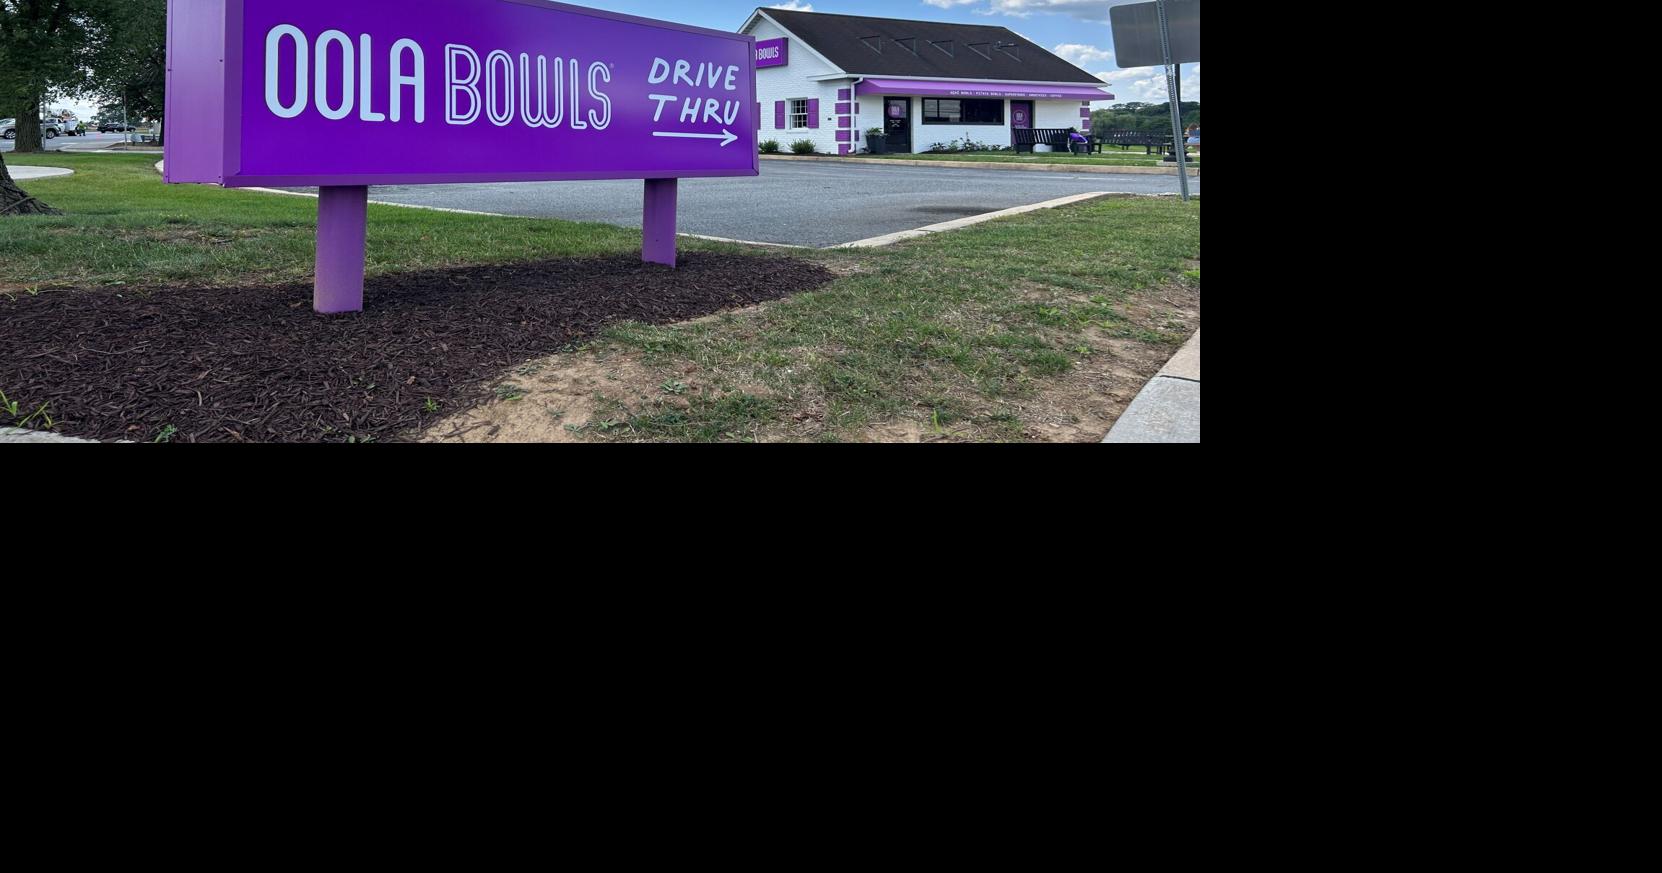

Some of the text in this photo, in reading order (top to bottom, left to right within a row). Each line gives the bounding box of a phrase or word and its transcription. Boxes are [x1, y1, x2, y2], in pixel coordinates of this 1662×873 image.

[758, 46, 779, 60] BOWLS
[265, 24, 612, 131] OOLA BOWLS
[647, 57, 740, 91] DRIVE
[648, 93, 740, 126] THRU
